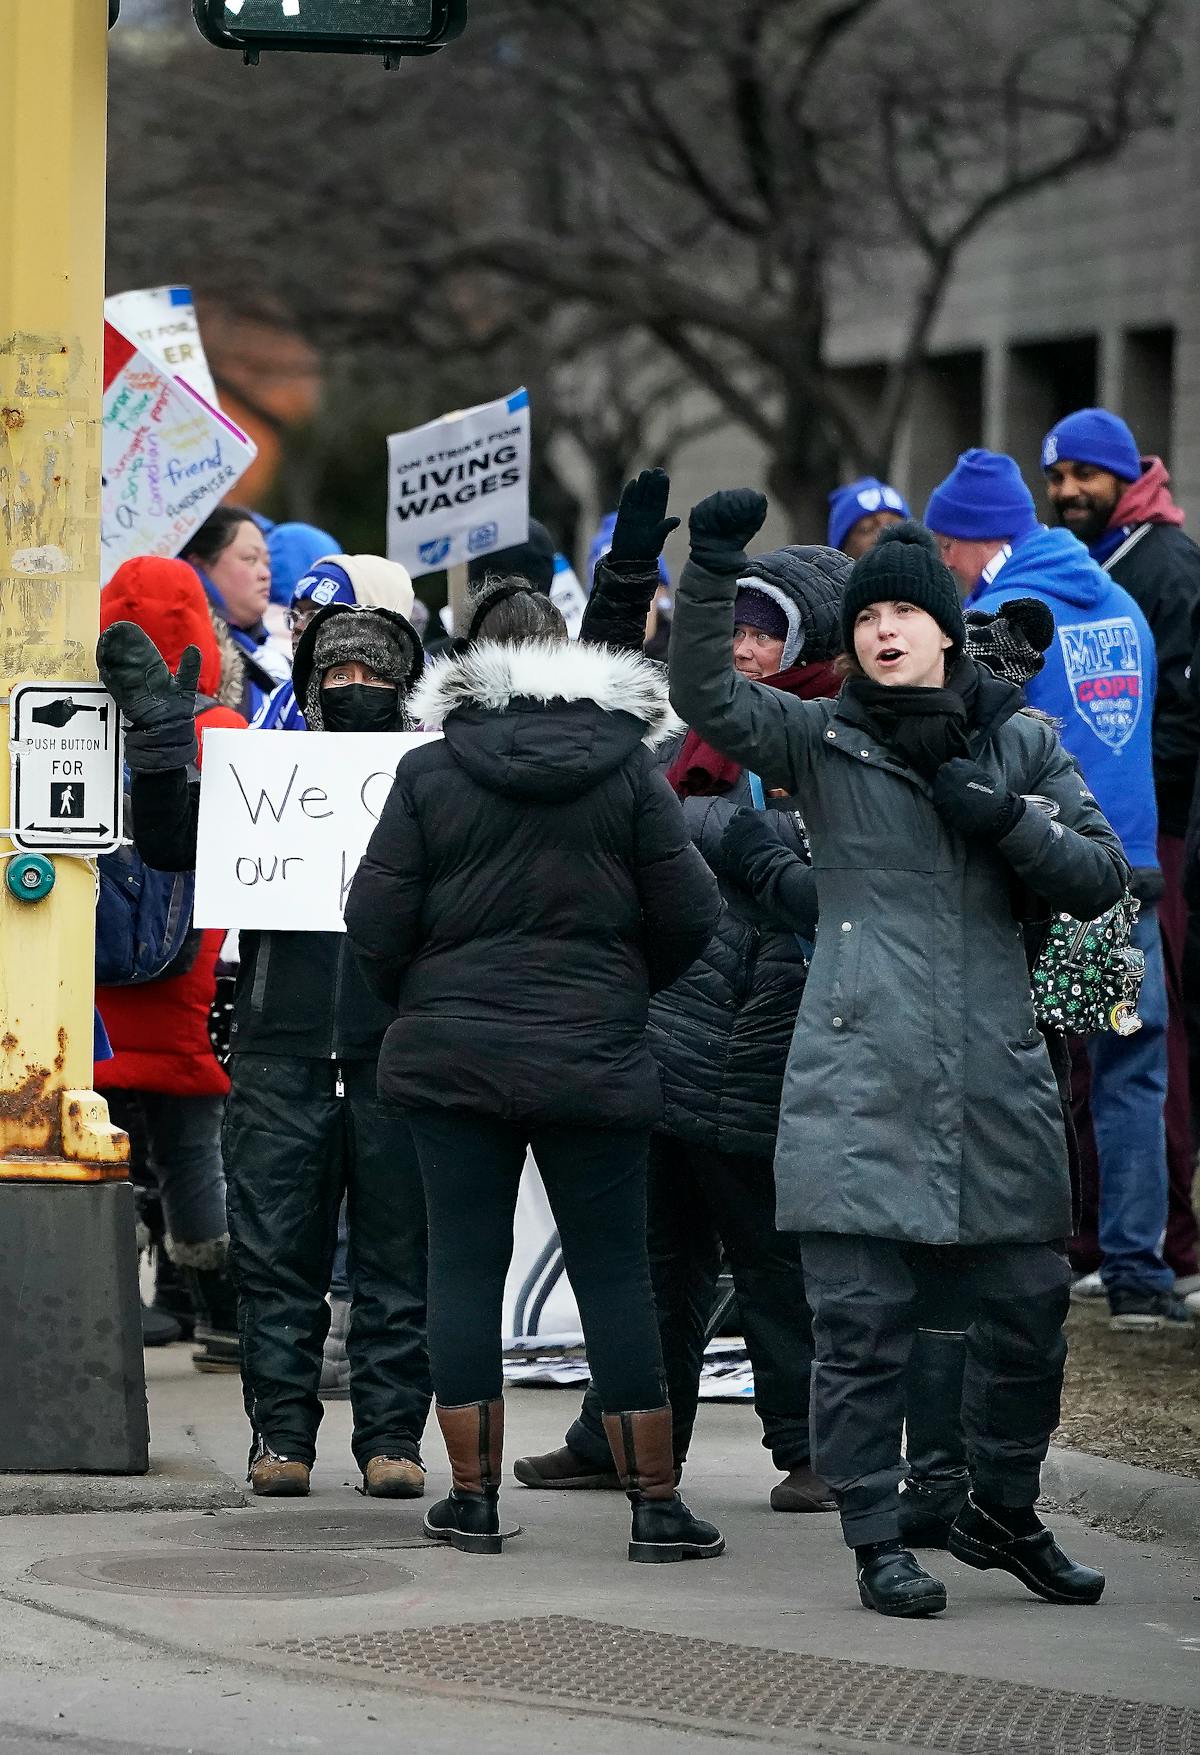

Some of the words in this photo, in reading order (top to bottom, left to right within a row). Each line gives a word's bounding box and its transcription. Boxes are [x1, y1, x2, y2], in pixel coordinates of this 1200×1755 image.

[164, 438, 222, 487] friend
[401, 445, 518, 497] LIVING
[397, 468, 520, 521] WAGES
[1064, 628, 1137, 676] MFT
[27, 738, 56, 750] PUSH
[61, 738, 100, 751] BUTTON
[53, 760, 83, 776] FOR
[229, 763, 335, 825] We
[235, 854, 305, 886] our
